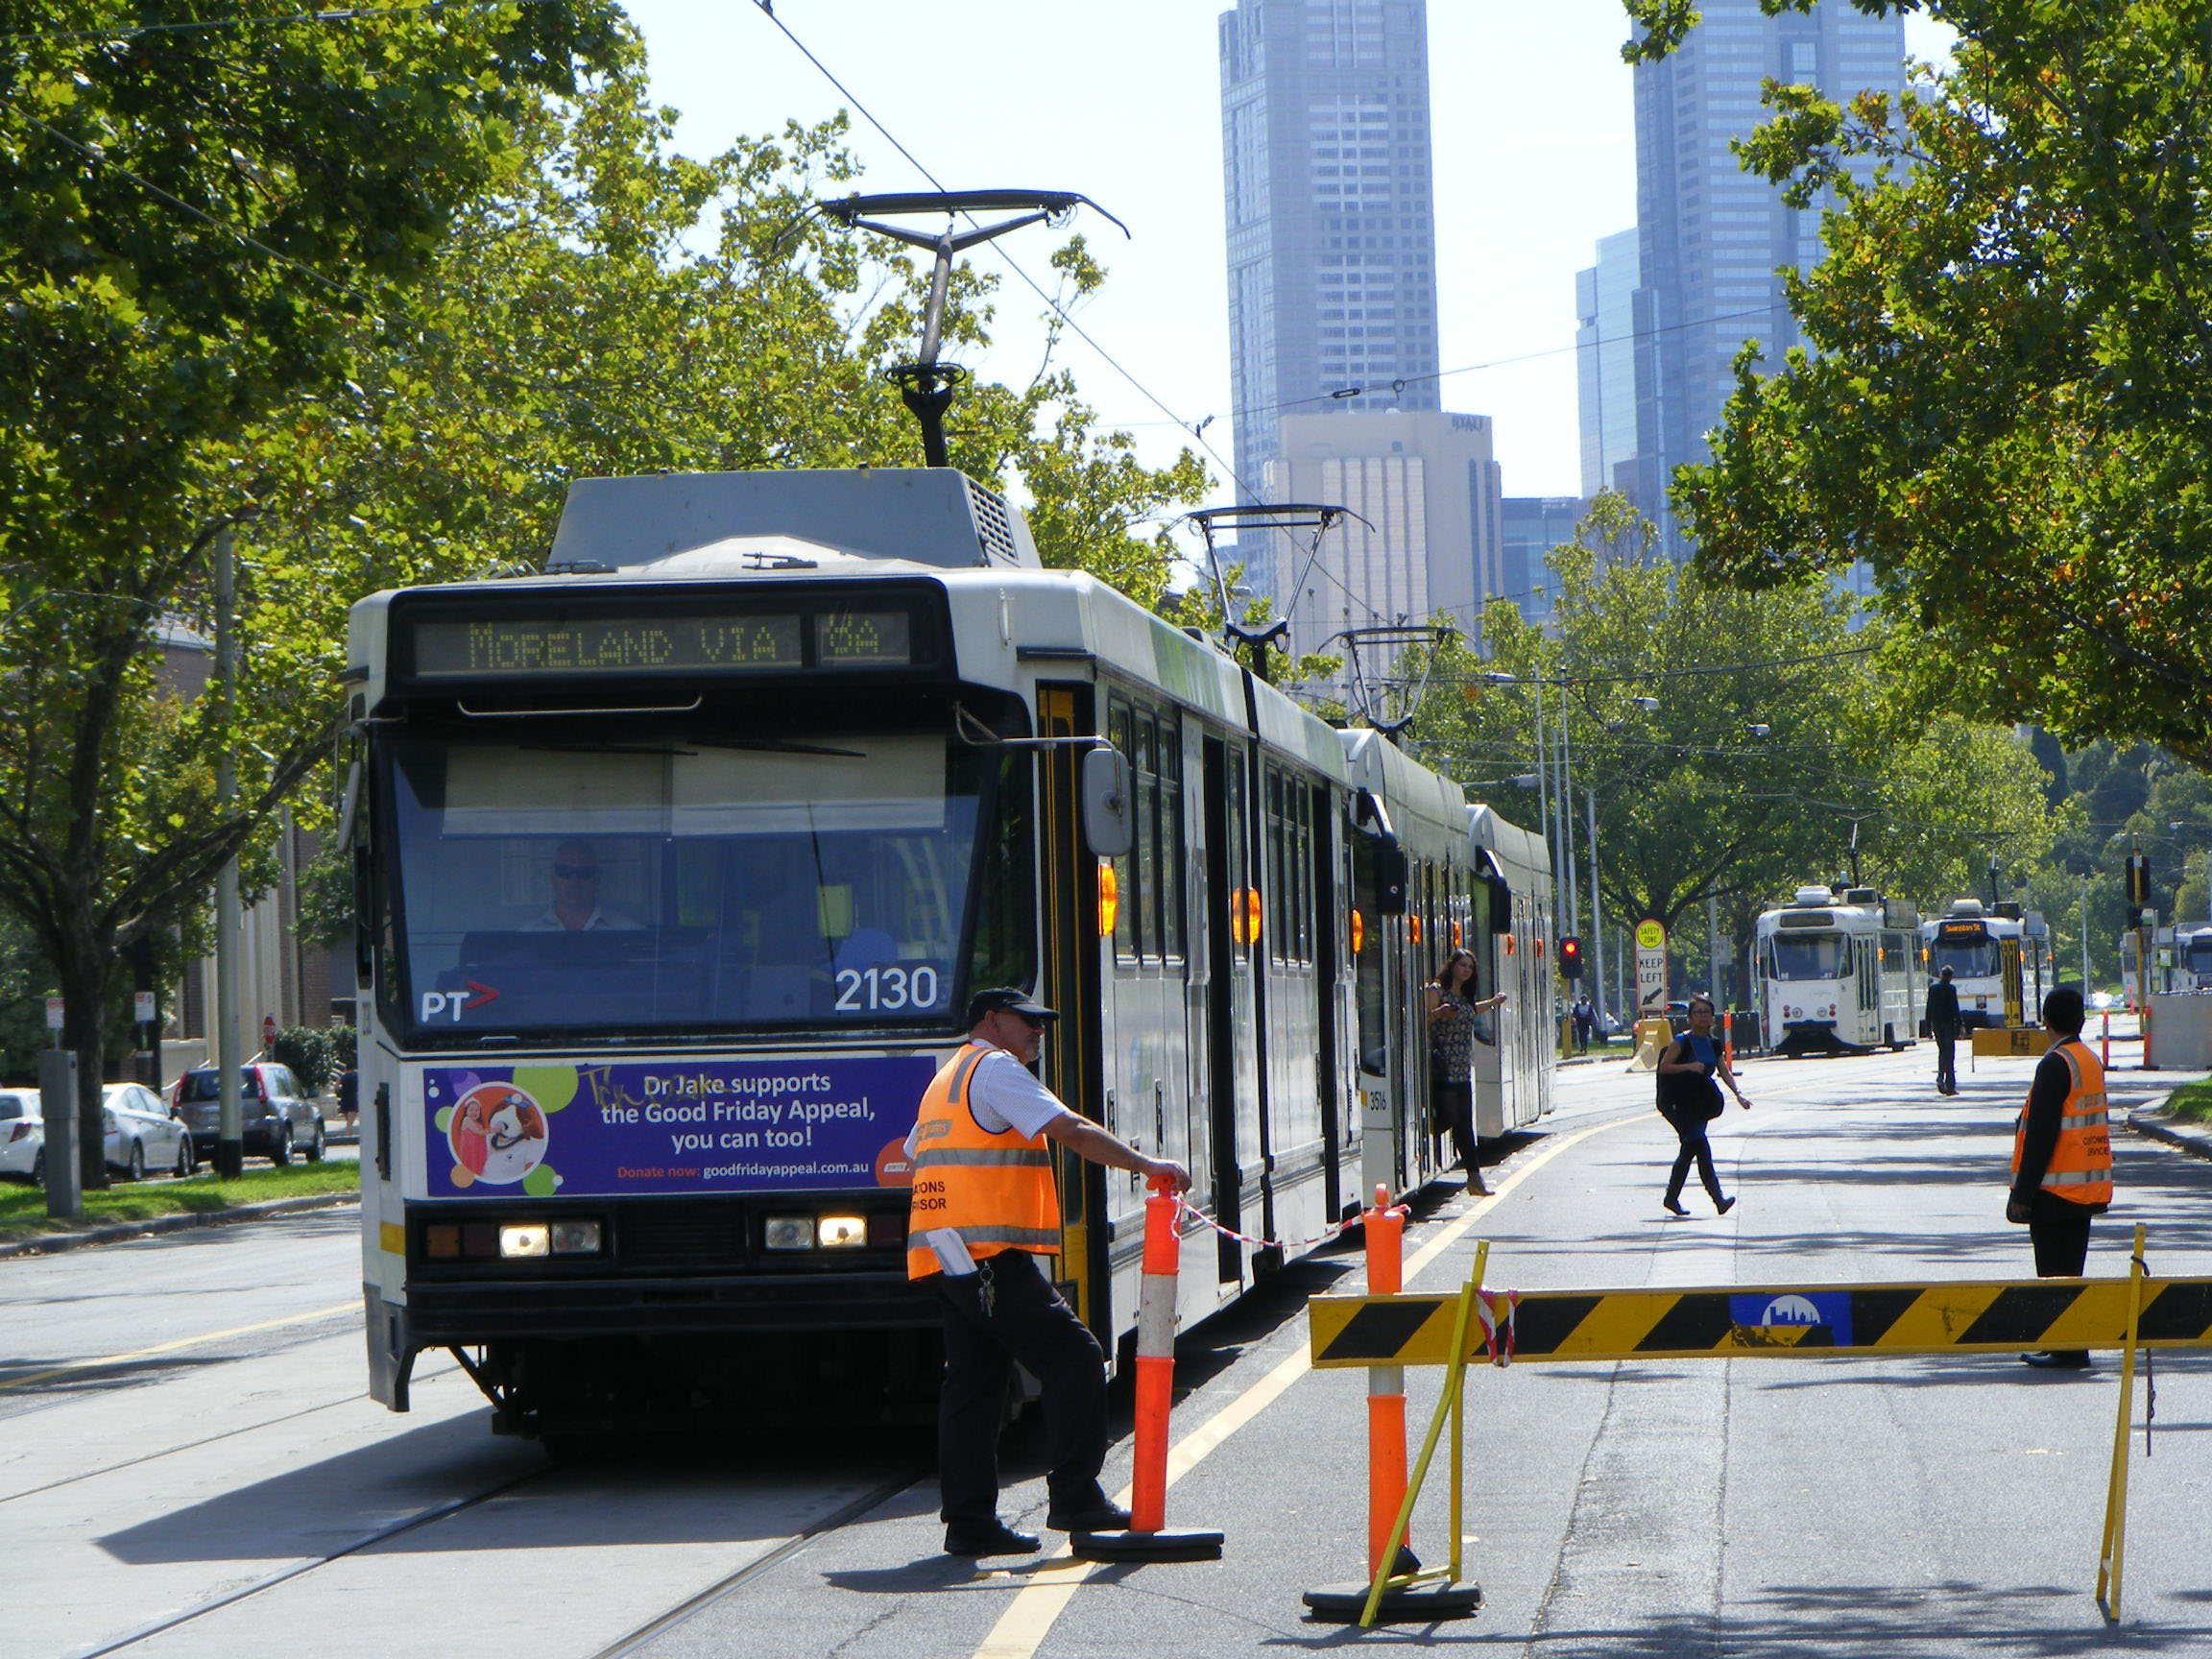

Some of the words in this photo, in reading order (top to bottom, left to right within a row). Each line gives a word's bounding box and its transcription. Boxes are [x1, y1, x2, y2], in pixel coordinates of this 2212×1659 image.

[469, 622, 673, 668] MORELAND
[701, 627, 776, 661] VIA
[1639, 958, 1663, 969] KEEP
[834, 966, 937, 1011] 2130
[1640, 973, 1662, 983] LEFT
[644, 1075, 671, 1096] Dr
[675, 1073, 725, 1094] Jake
[732, 1072, 831, 1098] supports
[601, 1103, 639, 1124] the
[645, 1101, 707, 1123] Good
[713, 1099, 782, 1125] Friday
[787, 1096, 877, 1123] Appeal,
[1369, 1091, 1386, 1111] 3516
[671, 1134, 714, 1155] you
[719, 1131, 759, 1149] can
[764, 1126, 813, 1147] too!
[617, 1166, 665, 1179] Donate
[668, 1166, 700, 1178] now:
[703, 1162, 870, 1180] goodfridayappeal.com.au
